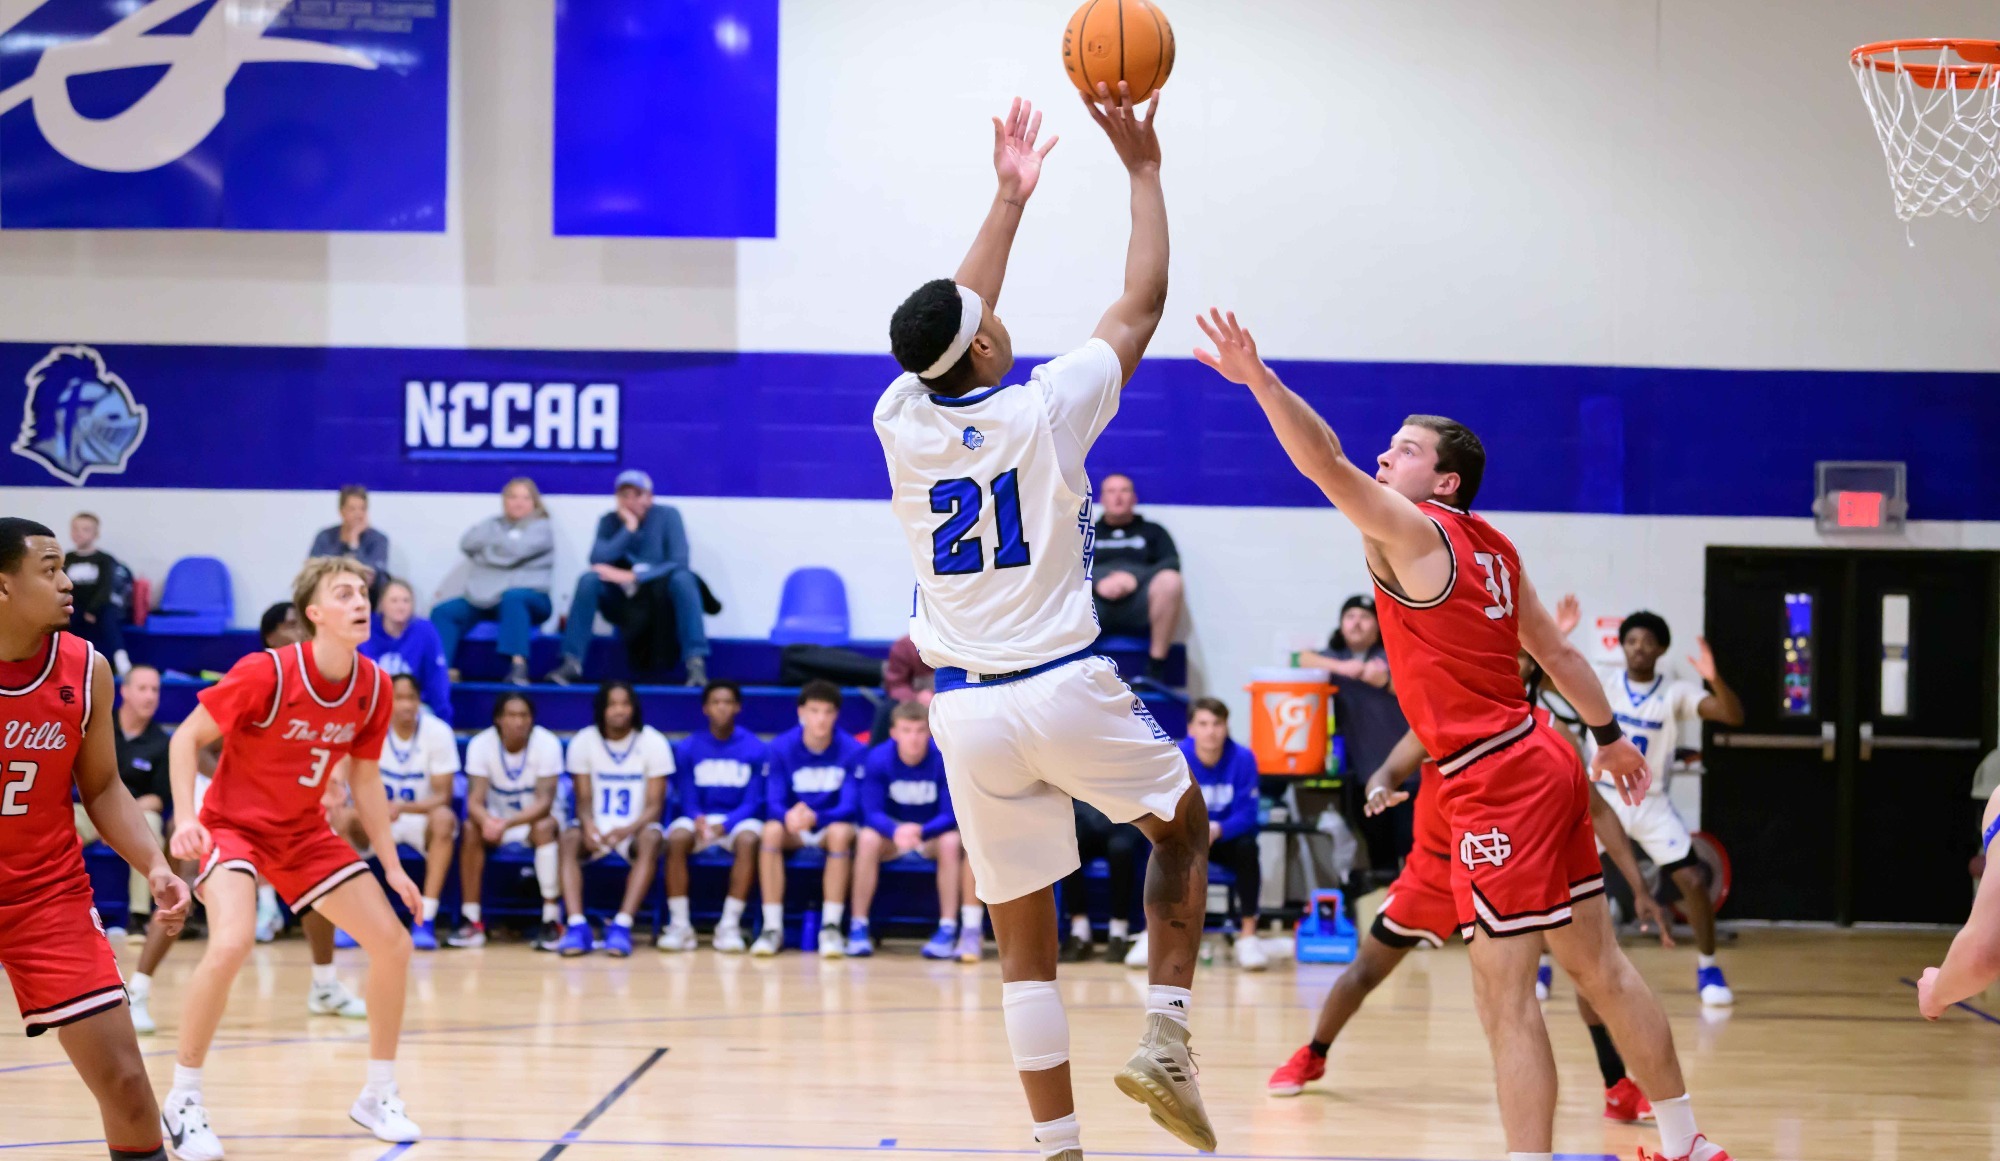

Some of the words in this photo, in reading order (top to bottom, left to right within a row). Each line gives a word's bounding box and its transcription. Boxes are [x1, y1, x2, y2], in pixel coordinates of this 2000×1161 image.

[405, 380, 619, 450] NCCAA
[928, 467, 1031, 576] 21
[1473, 551, 1514, 620] 31
[282, 719, 319, 740] The
[1279, 696, 1306, 725] G
[4, 720, 67, 750] Ville
[297, 747, 330, 788] 3
[0, 761, 39, 816] 2
[602, 788, 630, 817] 13
